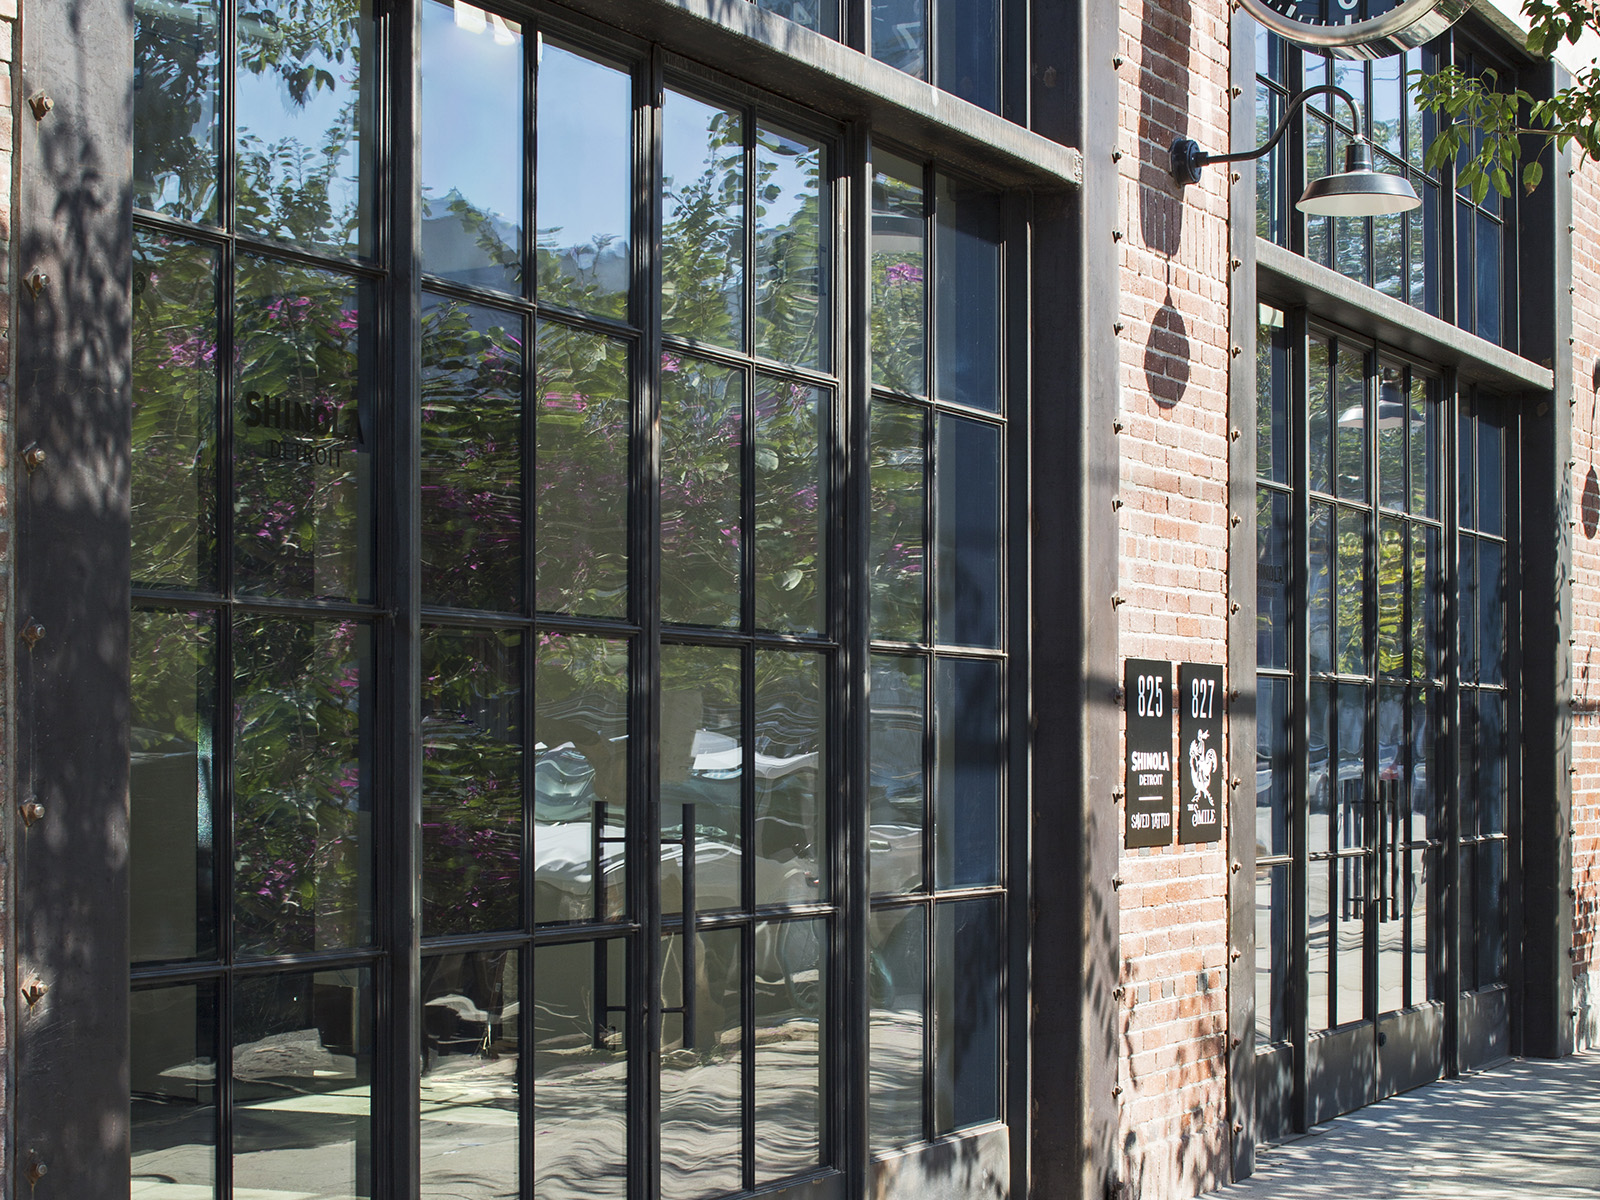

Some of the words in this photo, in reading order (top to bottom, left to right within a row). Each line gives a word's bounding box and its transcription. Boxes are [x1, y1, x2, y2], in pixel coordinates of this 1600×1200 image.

[244, 391, 364, 445] SHINOLA
[268, 439, 345, 468] DETROIT
[1138, 675, 1163, 717] 825
[1191, 678, 1215, 718] 827
[1131, 751, 1170, 772] SHINOLA
[1139, 774, 1163, 786] DETROIT
